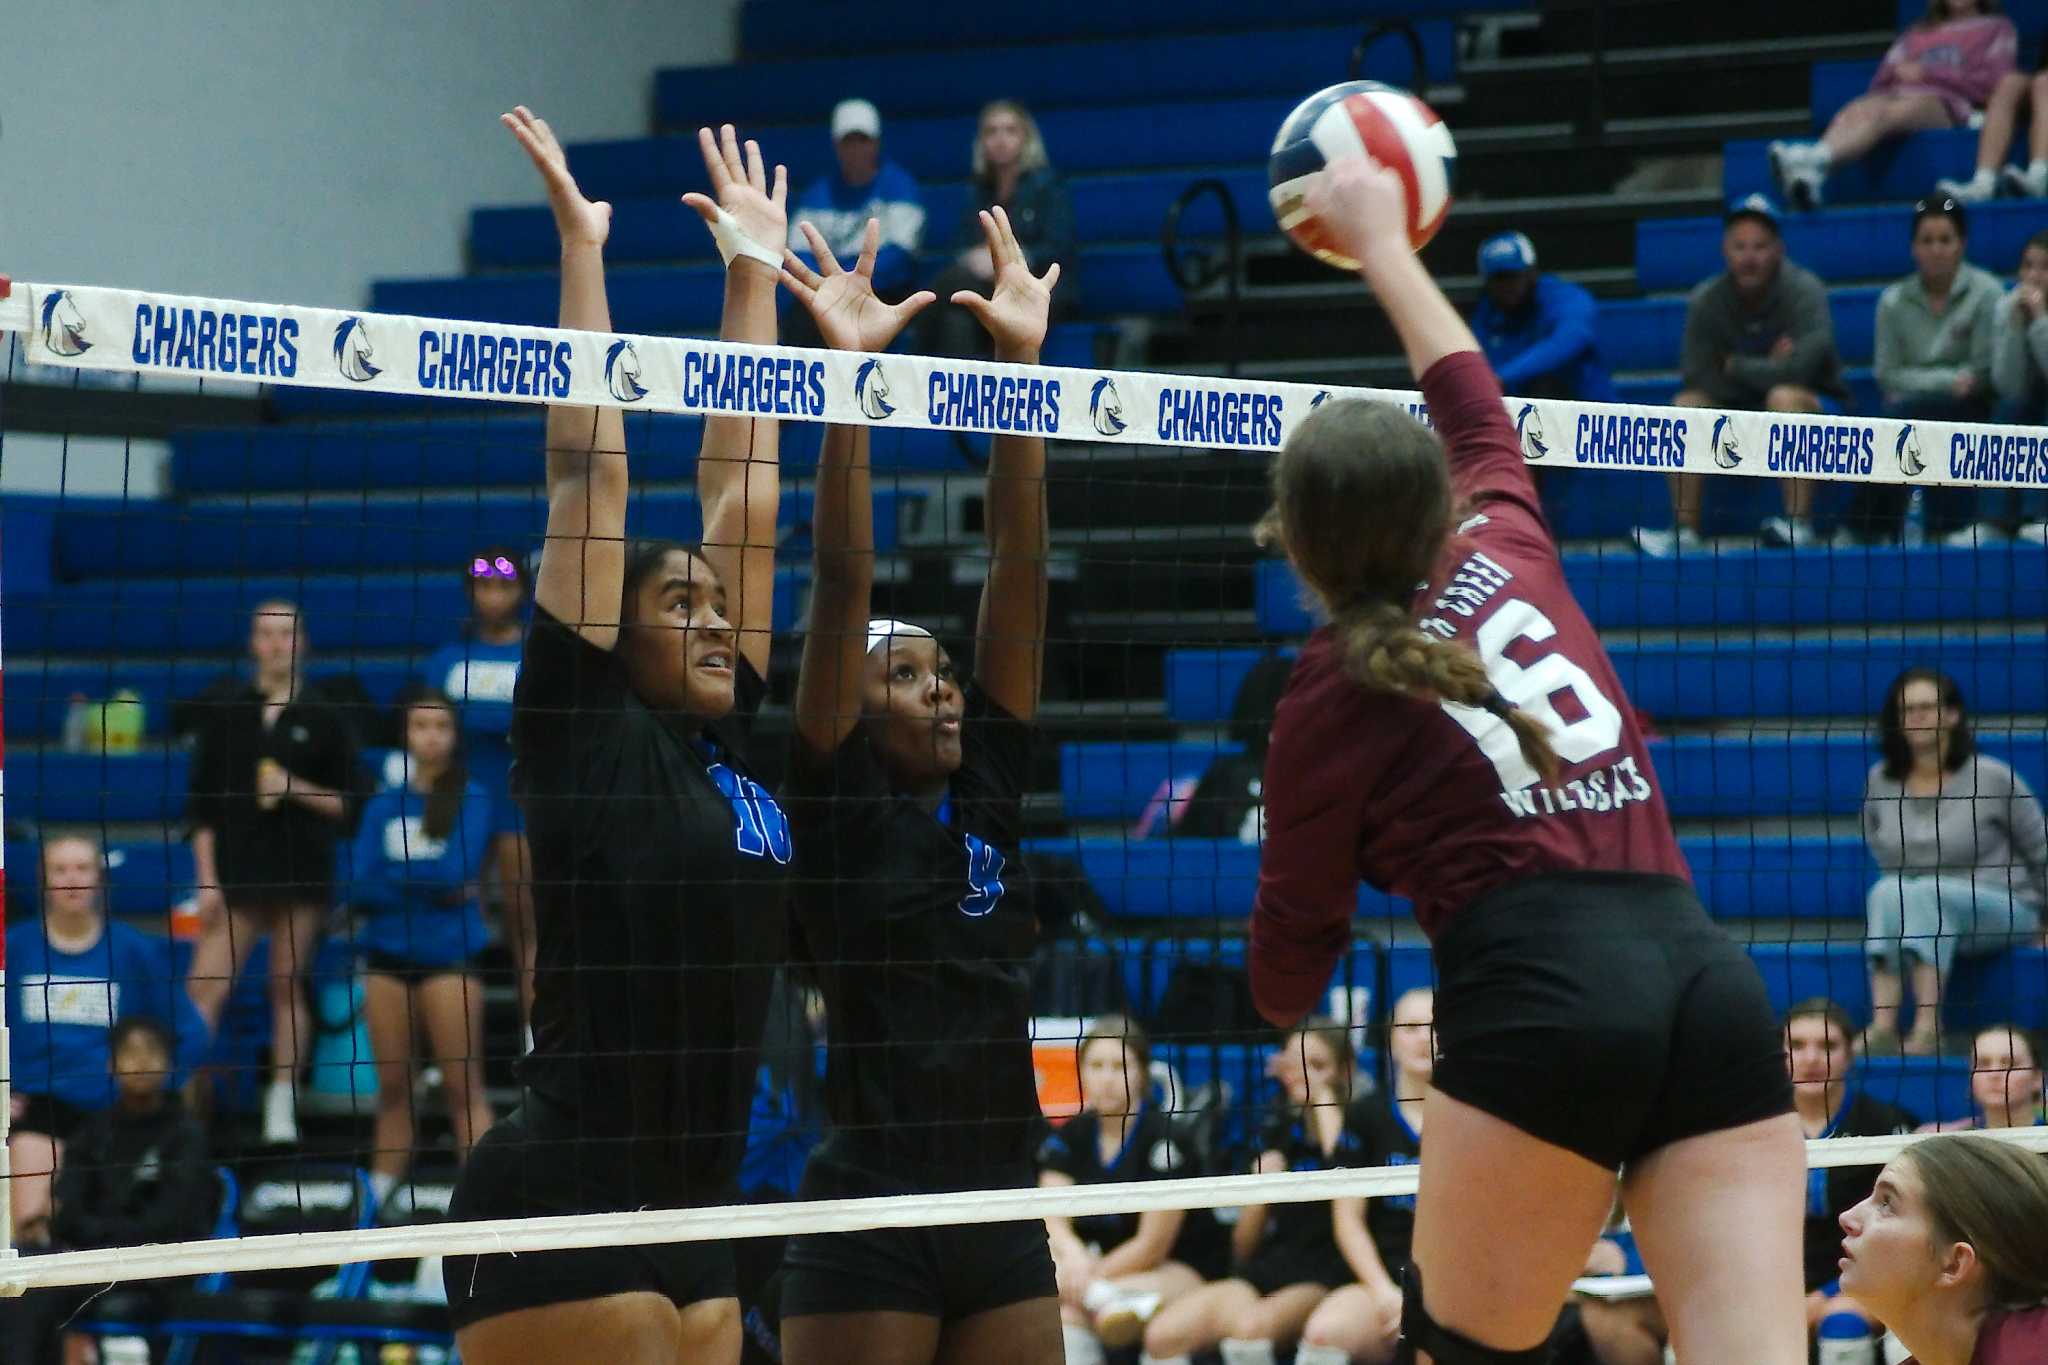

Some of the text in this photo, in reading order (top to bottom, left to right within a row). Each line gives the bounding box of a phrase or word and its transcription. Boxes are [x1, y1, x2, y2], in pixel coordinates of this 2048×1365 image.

[131, 303, 2048, 485] CHARGERS CHARGERS CHARGERS CHARGERS CHARGERS CHARGERS CHARGERS CHARGERS
[1439, 598, 1623, 793] 16
